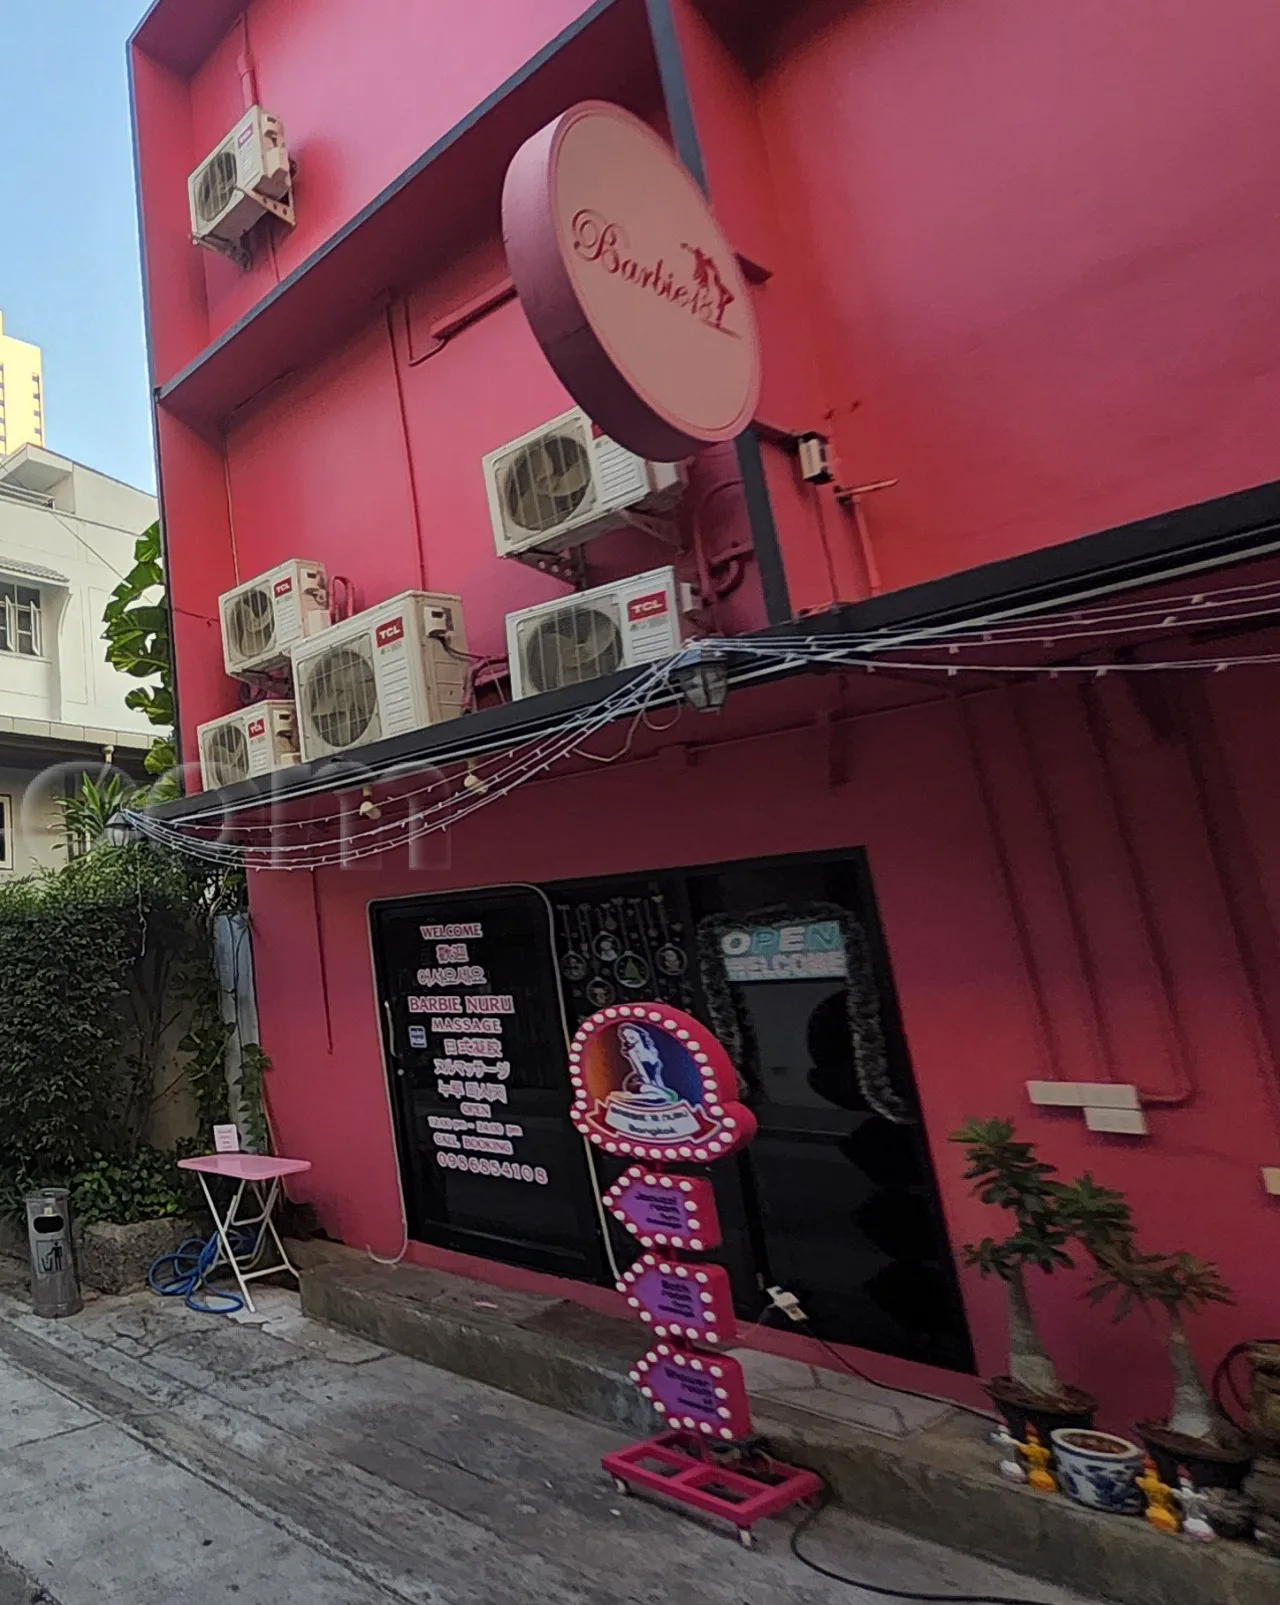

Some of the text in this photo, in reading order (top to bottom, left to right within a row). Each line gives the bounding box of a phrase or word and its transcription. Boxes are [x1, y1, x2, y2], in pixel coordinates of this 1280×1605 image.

[276, 582, 291, 594] TCL
[630, 599, 664, 614] TCL
[378, 625, 401, 640] TCL
[419, 922, 483, 940] WELCOME
[721, 921, 841, 956] OPEN
[408, 994, 515, 1014] BARBIE NURU
[431, 1017, 502, 1034] MASSAGE
[460, 1101, 491, 1119] OPEN
[433, 1132, 514, 1156] CALL BOOKING
